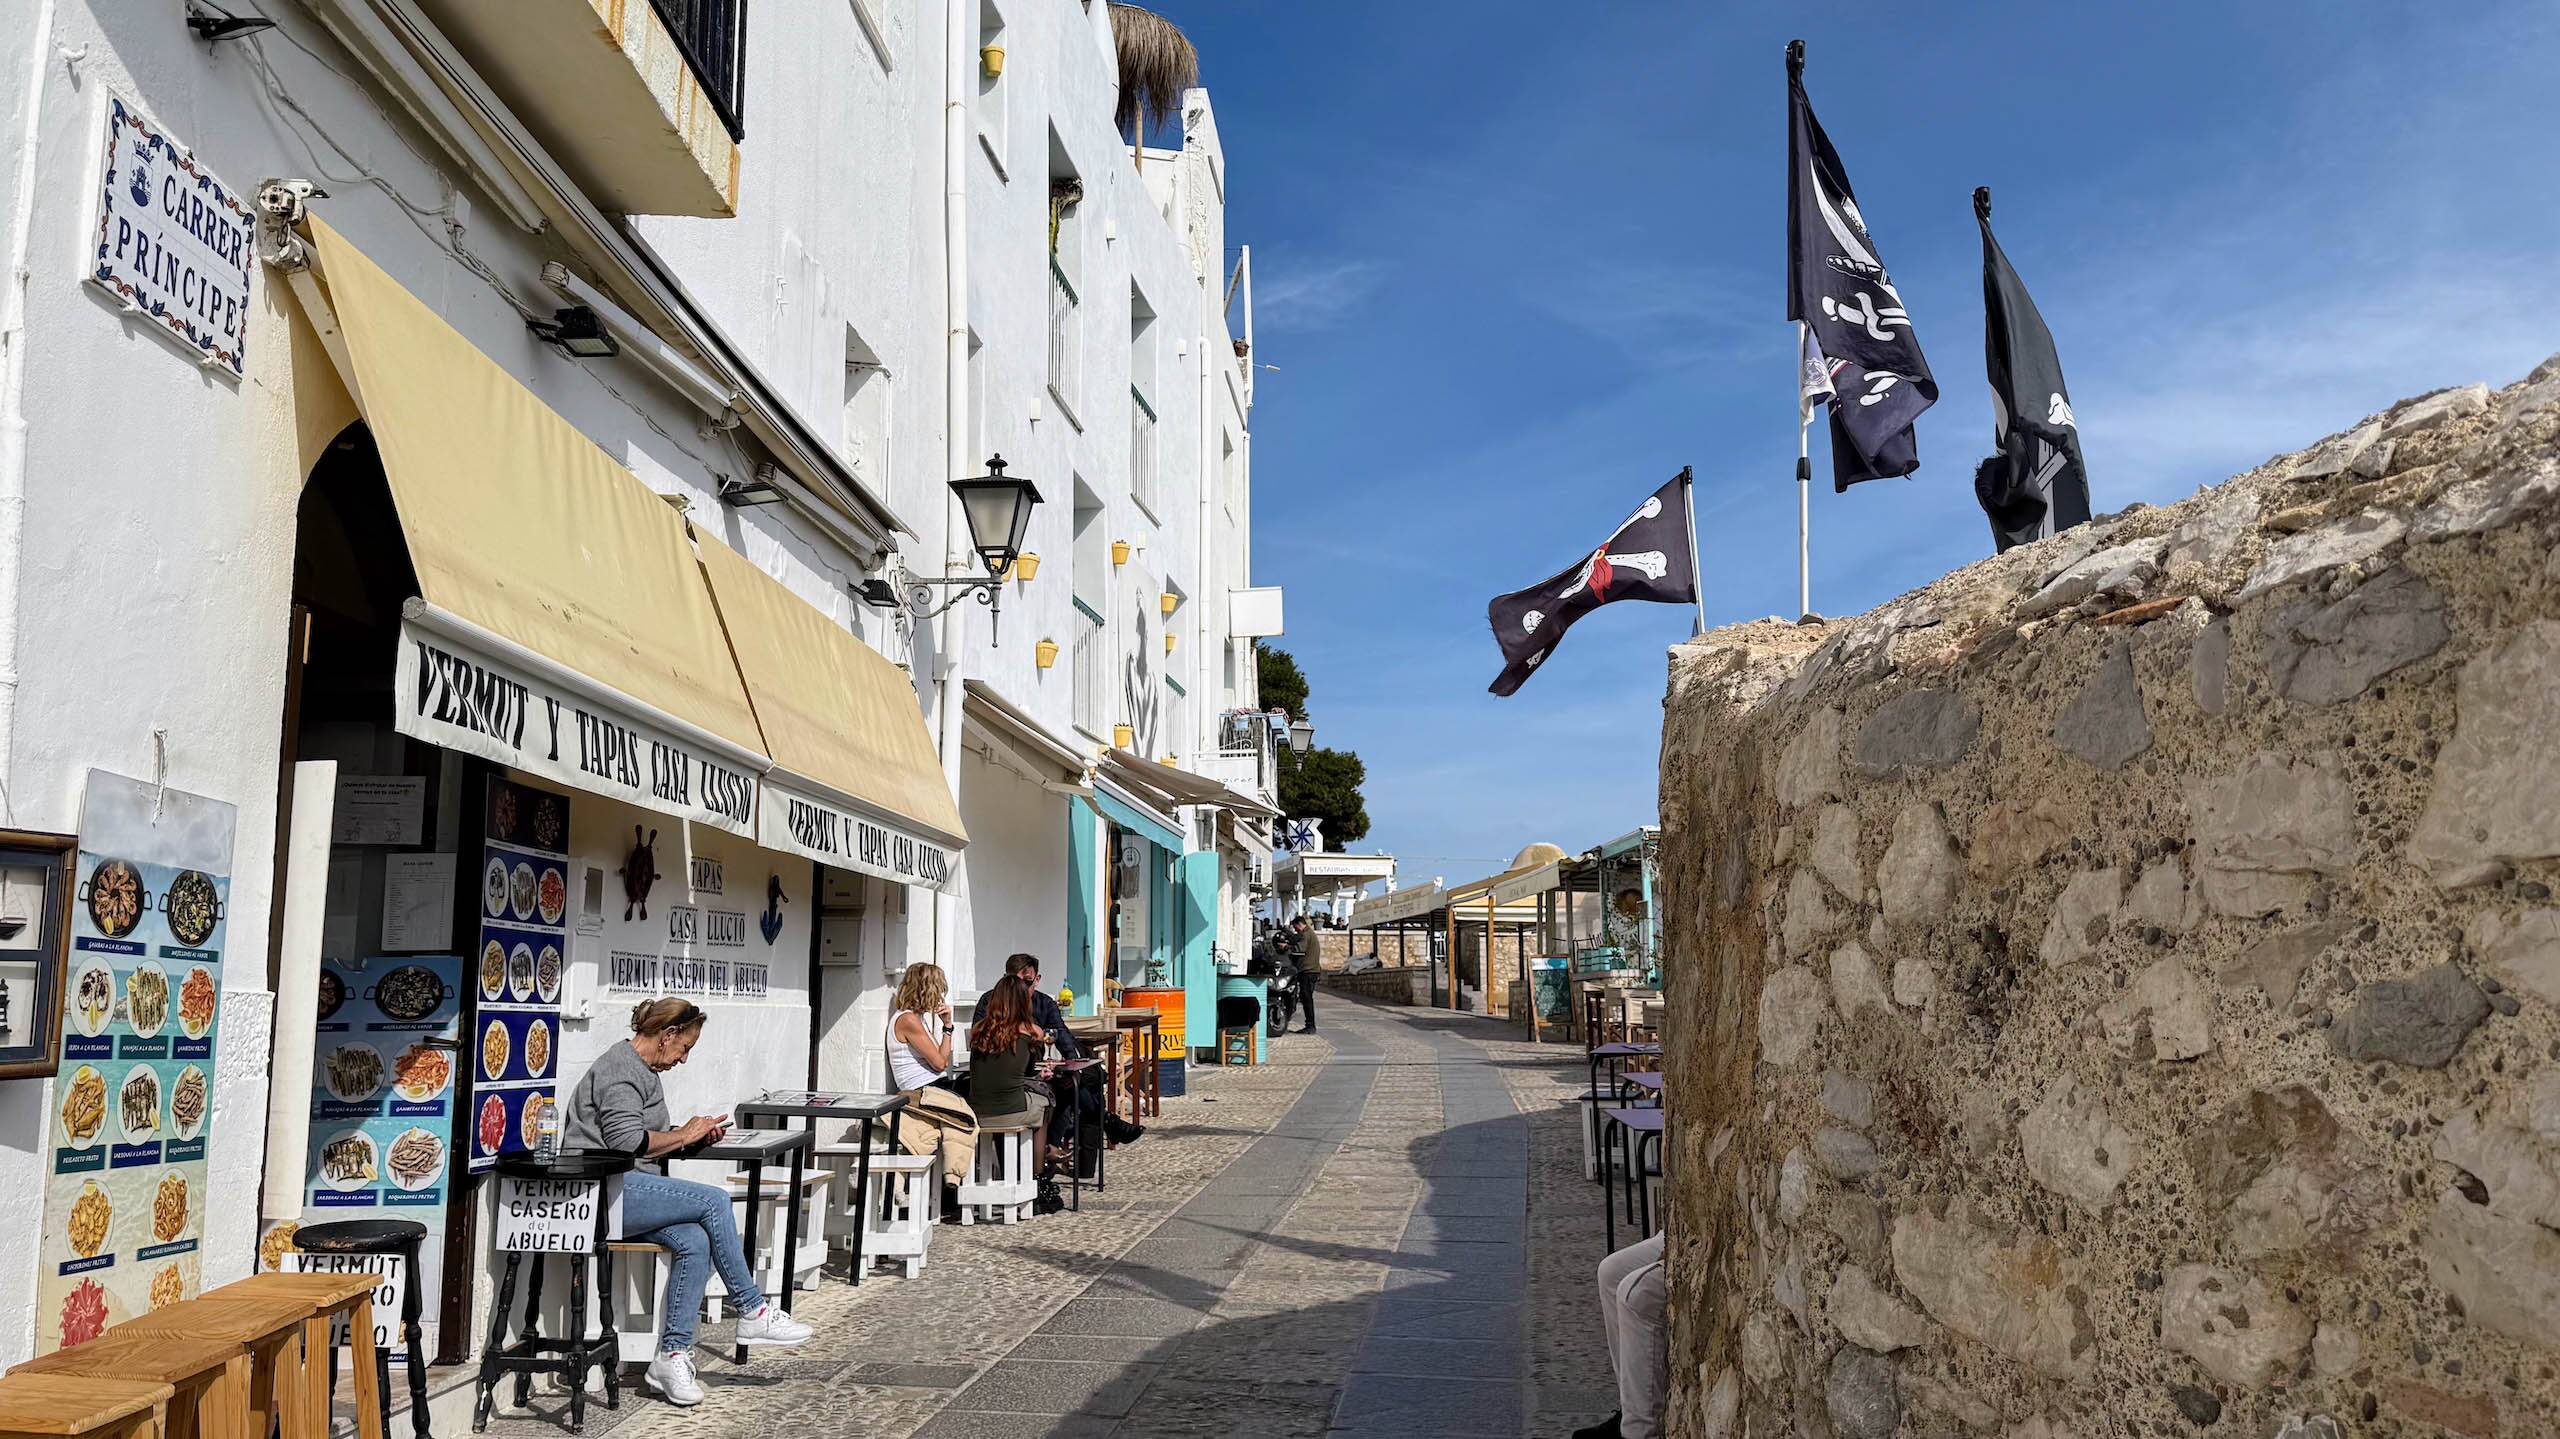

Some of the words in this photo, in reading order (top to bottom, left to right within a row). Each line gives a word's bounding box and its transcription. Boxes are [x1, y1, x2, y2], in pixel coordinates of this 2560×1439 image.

[163, 174, 242, 271] CARRER
[115, 216, 236, 338] PRÍNCIPE
[416, 640, 529, 750] VERMUT
[545, 696, 560, 762] Y
[576, 709, 640, 789] TAPAS
[652, 740, 692, 806] CASA
[701, 760, 752, 824] LLUCIO
[788, 799, 838, 854] VERMUT
[844, 818, 852, 858] Y
[858, 822, 888, 868] TAPAS
[894, 835, 914, 876] CASA
[918, 844, 948, 884] LLUCIO
[690, 862, 722, 890] TAPAS
[670, 912, 698, 940] CASA
[707, 914, 746, 942] LLUCIO
[611, 956, 657, 988] VERMUT
[663, 961, 704, 990] CASERO
[709, 965, 728, 991] DEL
[734, 968, 768, 992] ABUELO
[514, 1180, 595, 1200] VERMUT
[511, 1200, 590, 1220] CASERO
[528, 1221, 550, 1230] del
[506, 1232, 584, 1250] ABUELO
